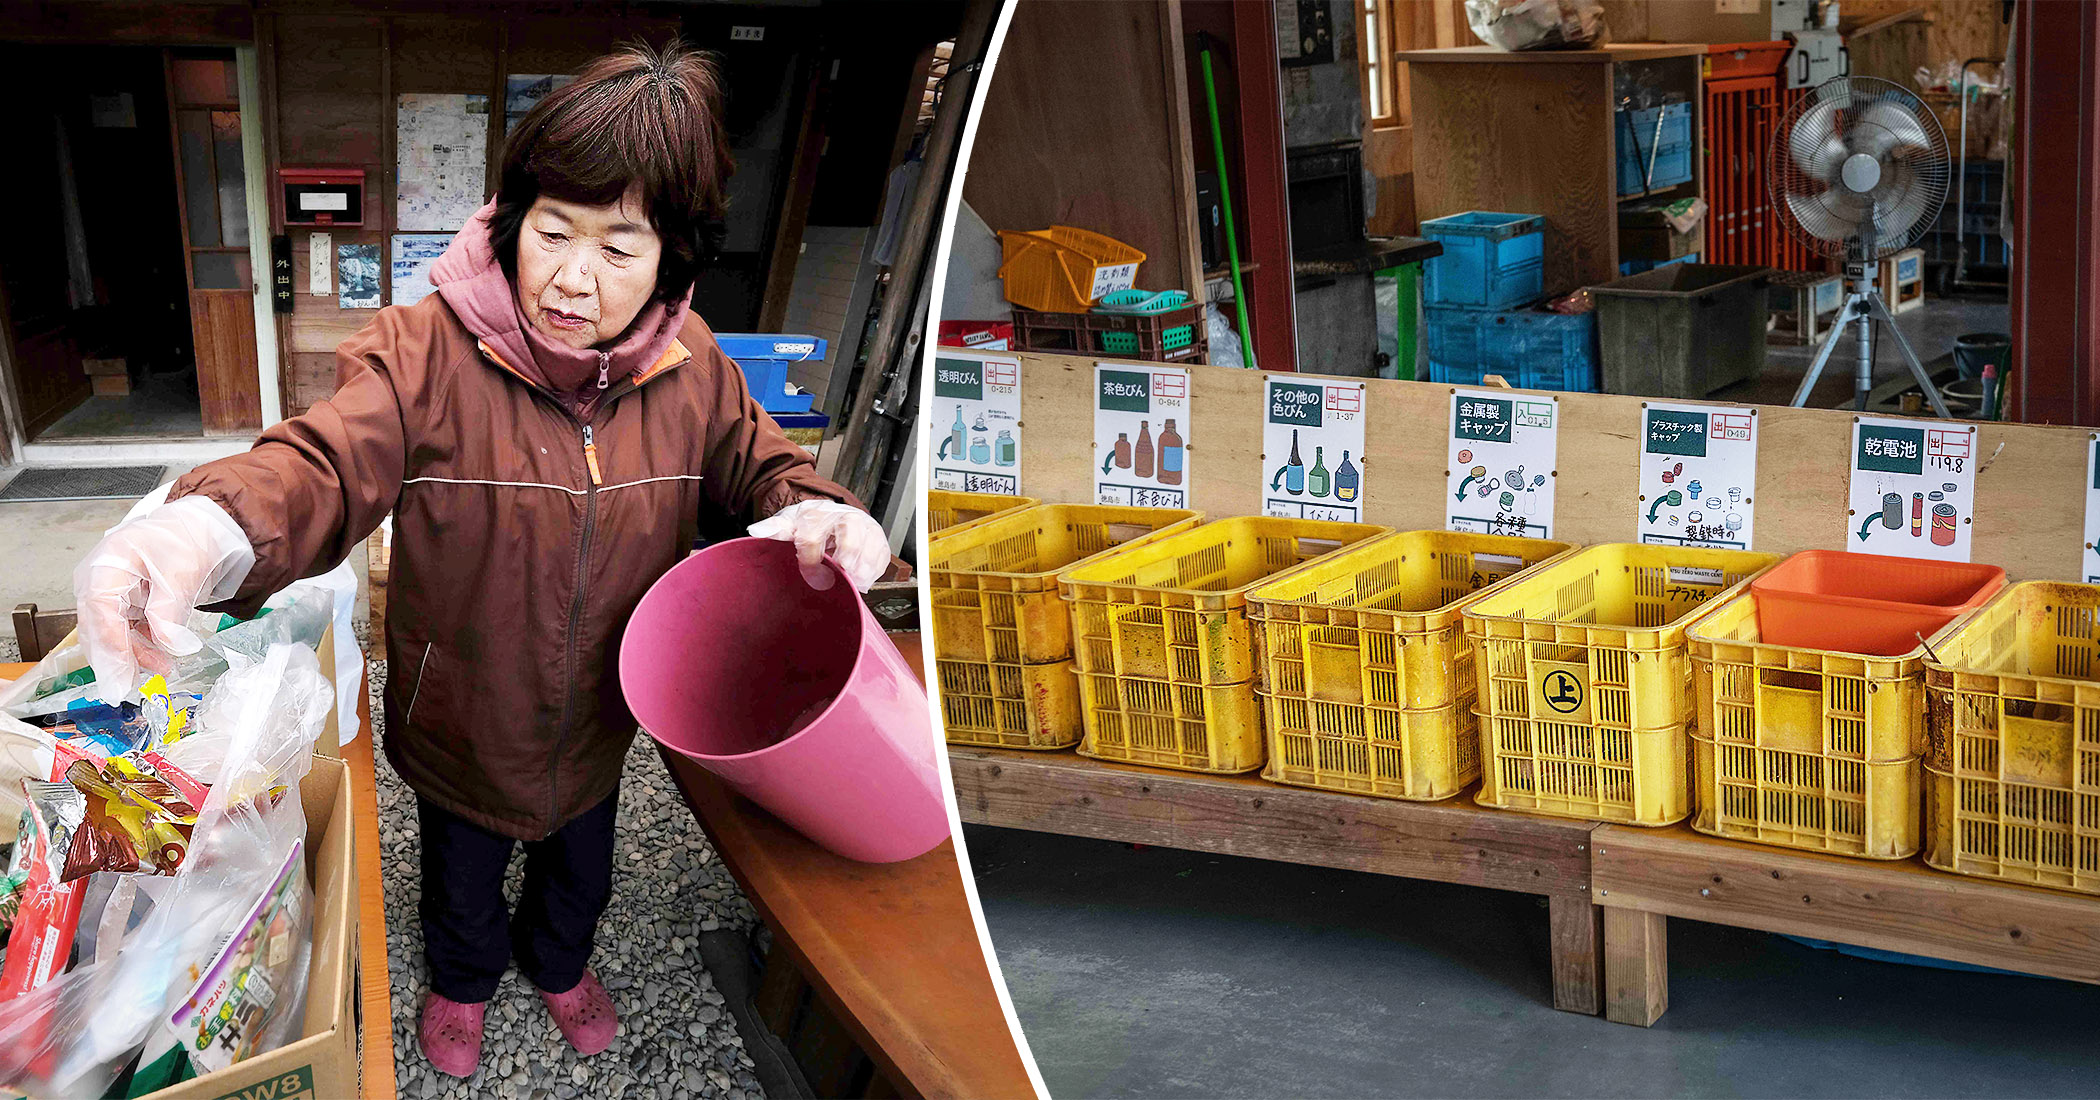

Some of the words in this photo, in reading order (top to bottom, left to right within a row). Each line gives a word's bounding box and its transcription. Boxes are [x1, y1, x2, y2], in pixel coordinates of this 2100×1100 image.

[276, 259, 290, 300] 外出中
[938, 369, 979, 385] 透明びん
[1103, 382, 1146, 397] 茶色びん
[1273, 388, 1320, 405] その他の
[1272, 402, 1307, 418] 色びん
[1460, 401, 1500, 419] 金属製
[1517, 409, 1527, 419] 入
[1460, 419, 1508, 436] キャップ
[1651, 420, 1703, 433] プラスチック製
[1714, 421, 1723, 432] 出
[1651, 432, 1681, 442] キャップ
[1930, 438, 1940, 449] 出
[1864, 437, 1918, 459] 乾電池
[1931, 456, 1964, 474] 119.8
[1136, 489, 1181, 507] 茶色びん
[1309, 510, 1340, 522] びん
[1495, 511, 1528, 534] 各種
[1549, 675, 1579, 704] 上
[200, 980, 226, 1017] カネハツ
